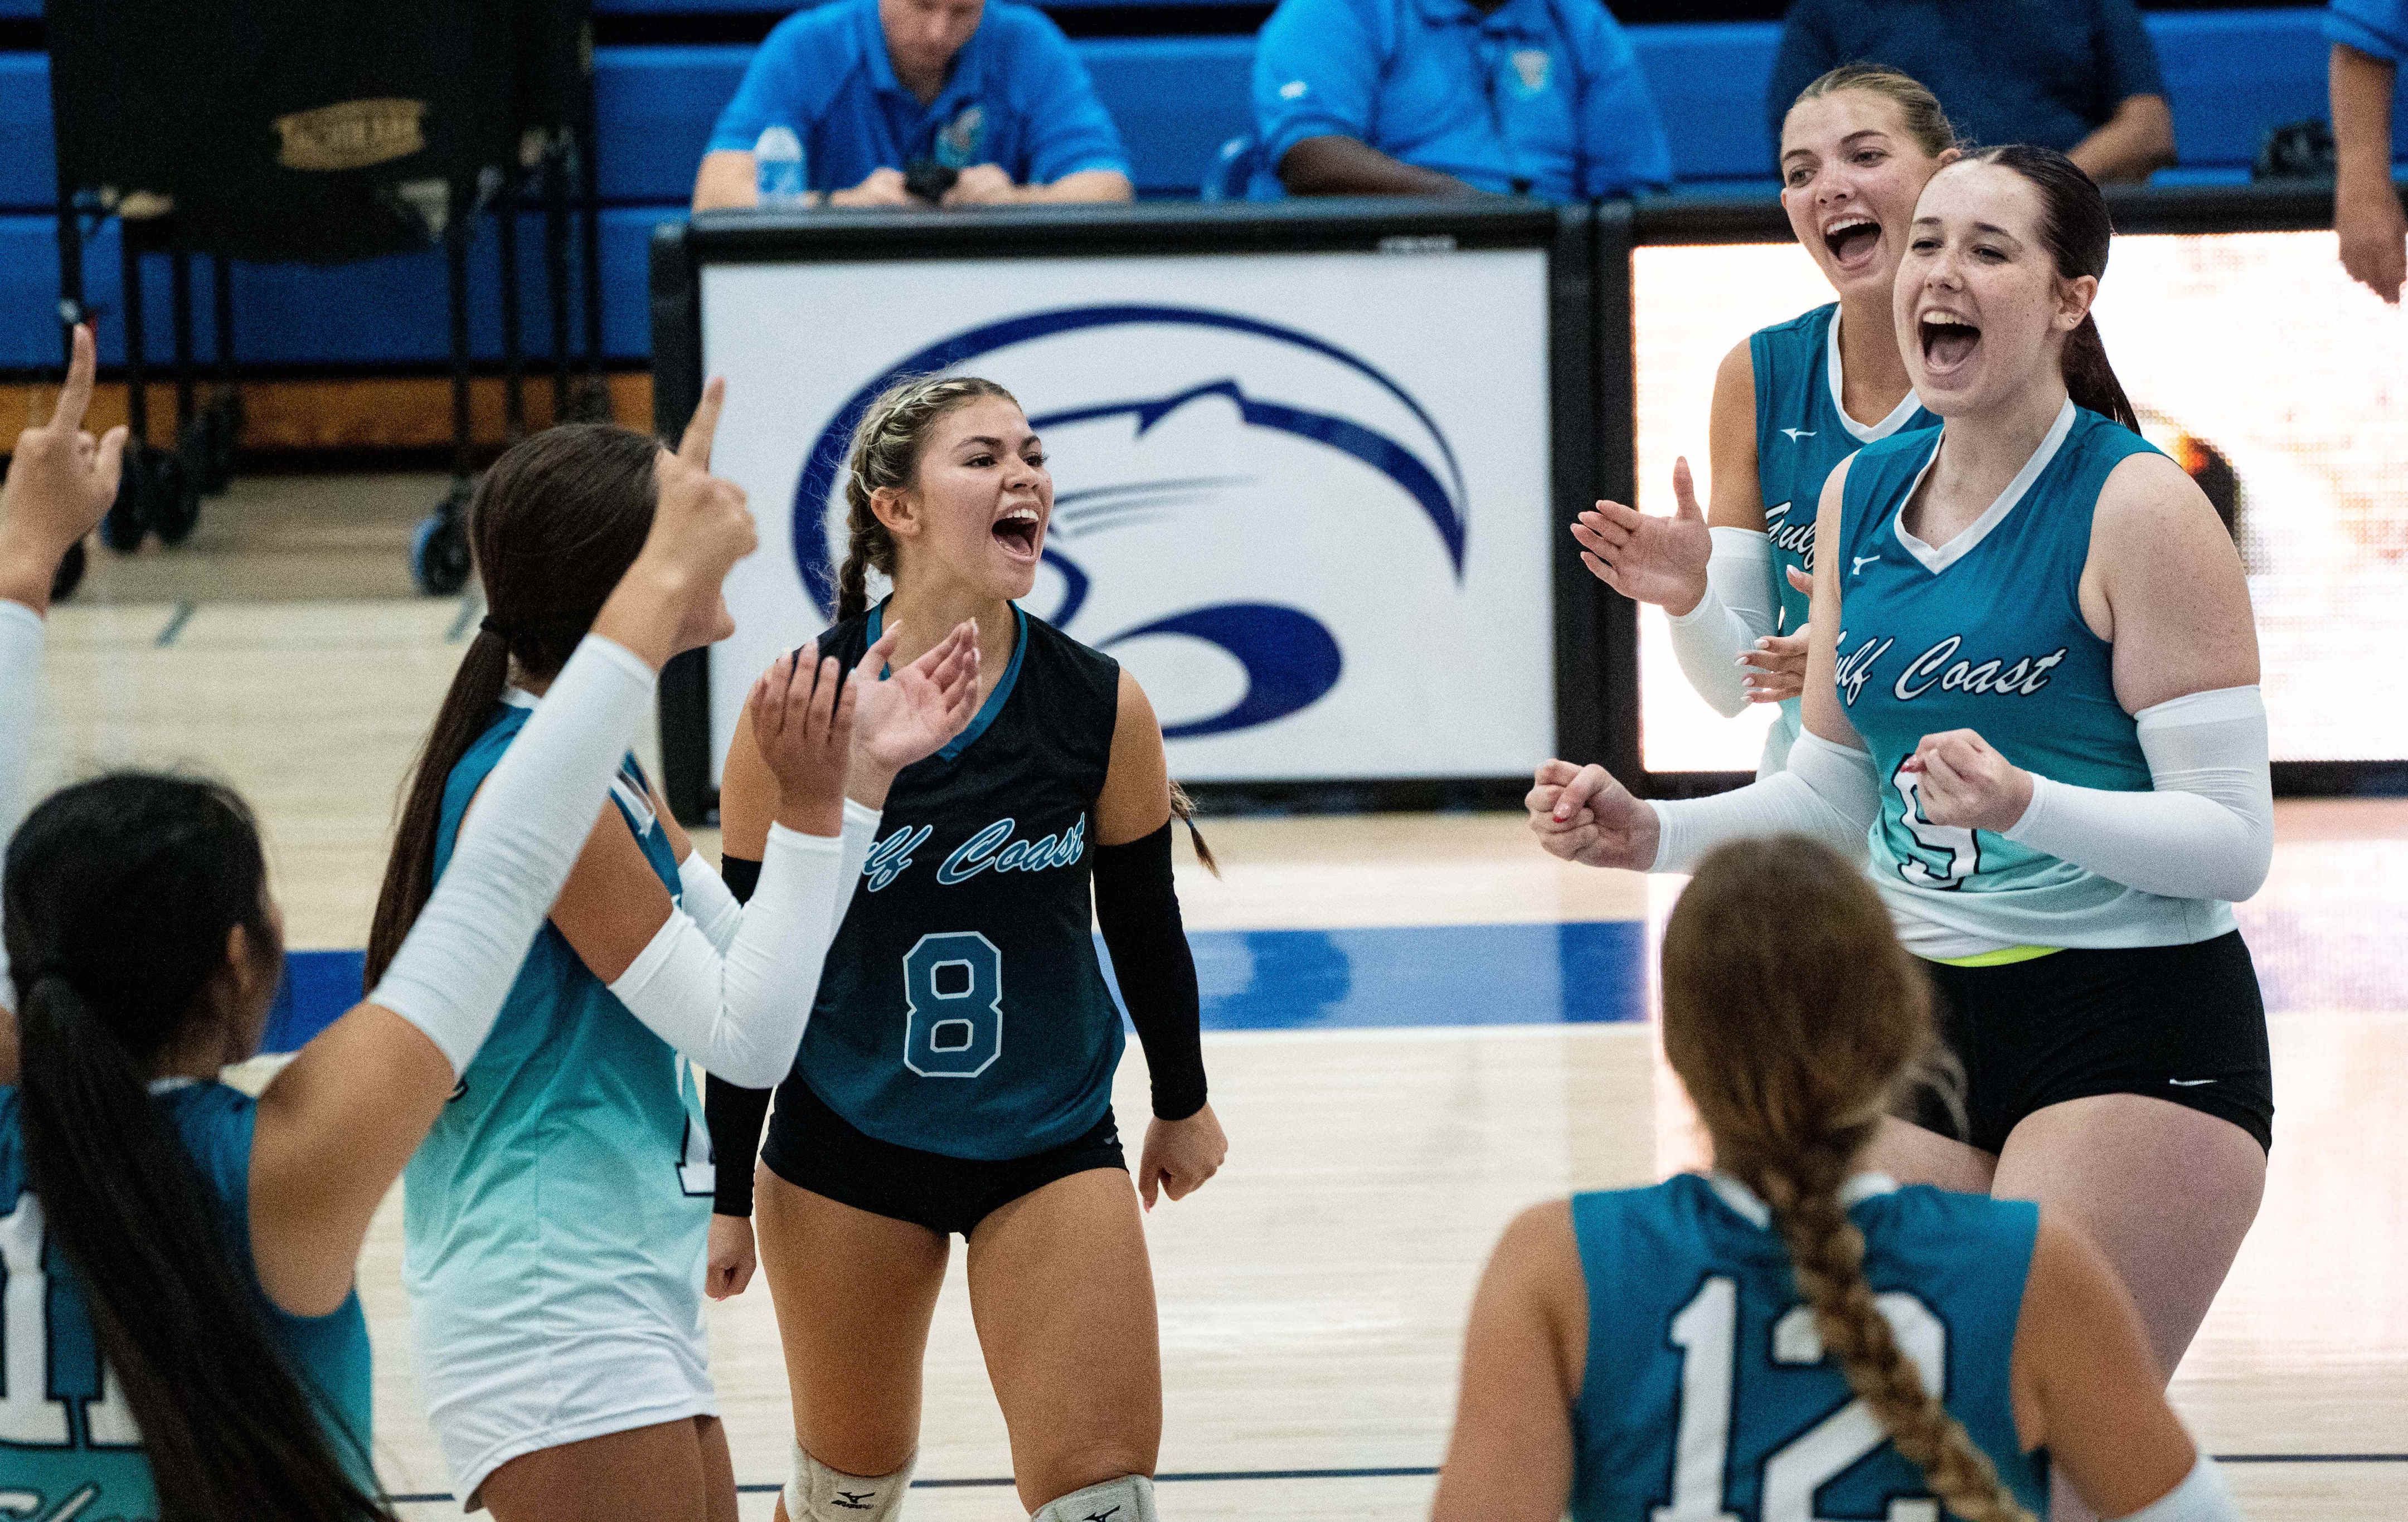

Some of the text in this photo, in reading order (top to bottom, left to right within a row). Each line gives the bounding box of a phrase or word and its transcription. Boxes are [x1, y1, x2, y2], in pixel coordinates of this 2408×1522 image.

[1835, 628, 2069, 708] ulf Coast
[936, 811, 1085, 885] Coast
[902, 931, 1003, 1078] 8
[1647, 1272, 1947, 1522] 12
